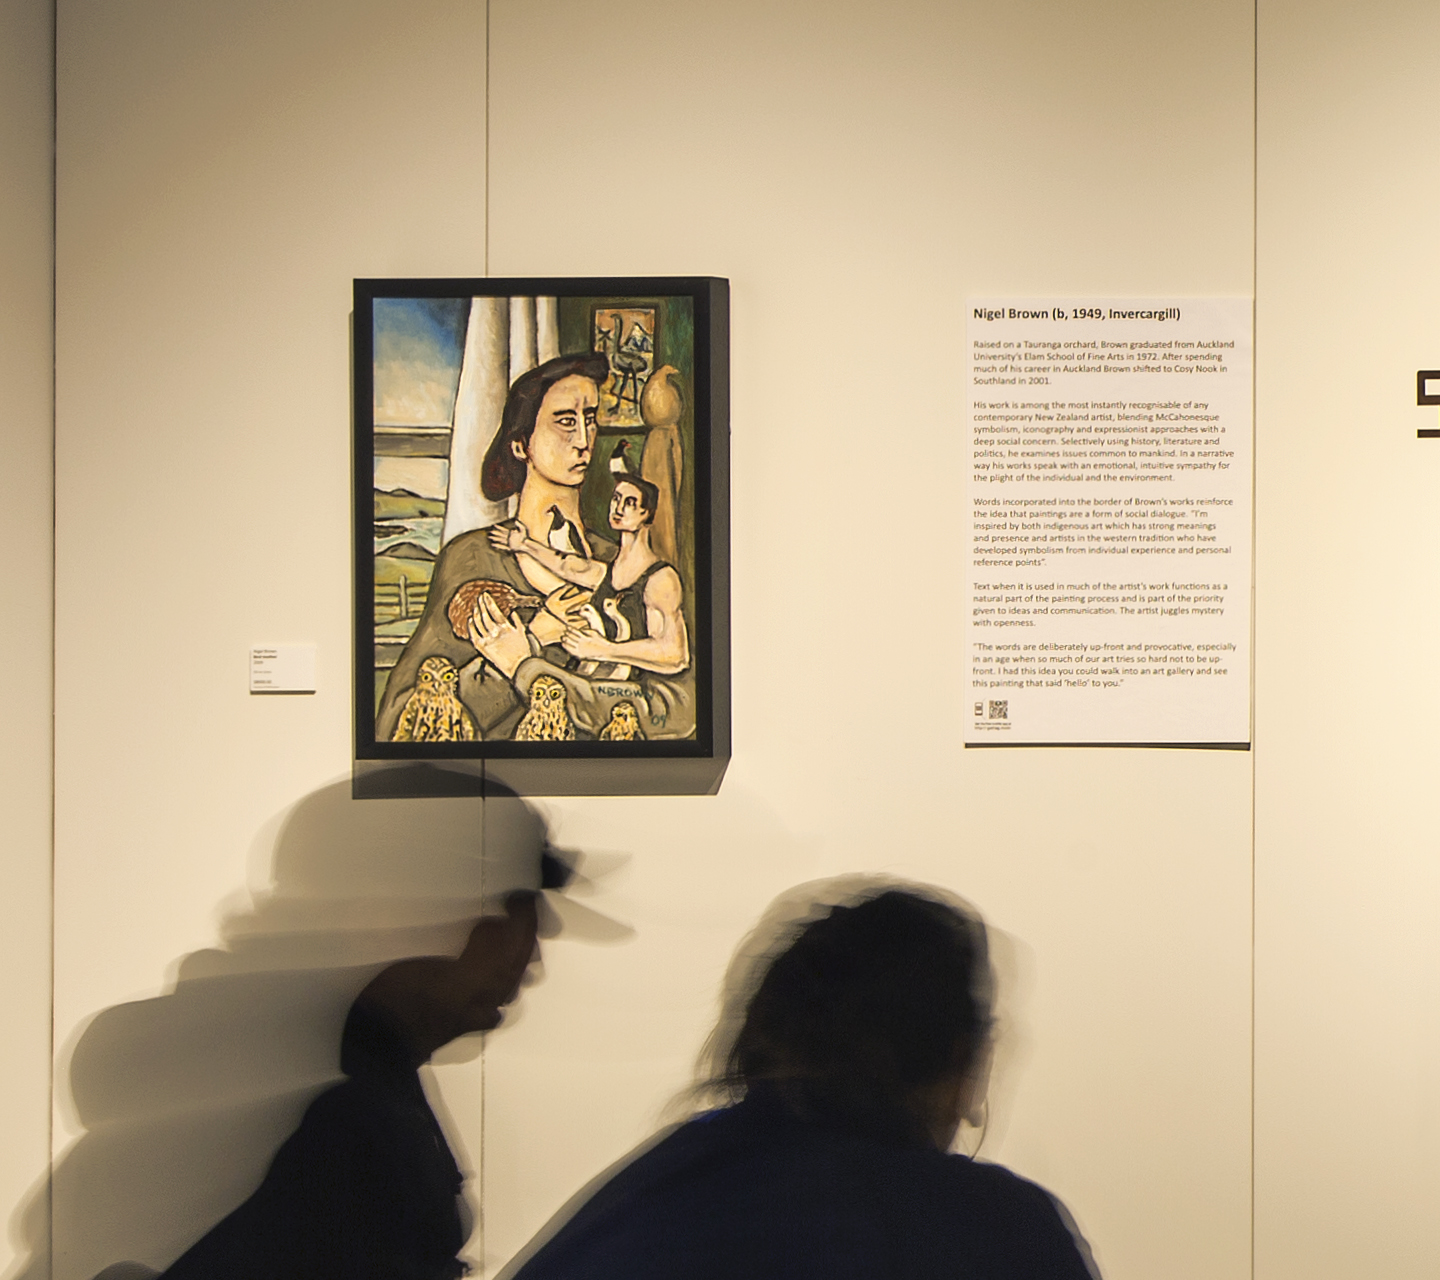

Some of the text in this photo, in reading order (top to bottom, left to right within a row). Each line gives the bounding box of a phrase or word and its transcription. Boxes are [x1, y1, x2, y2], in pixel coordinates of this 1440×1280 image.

[973, 308, 1005, 321] Nigel
[1008, 308, 1049, 319] Brown
[1109, 307, 1181, 321] Invercargill)
[1023, 340, 1062, 350] Tauranga
[1129, 340, 1173, 350] graduated
[1174, 340, 1195, 348] from
[1196, 340, 1235, 348] Auckland
[973, 365, 997, 373] much
[999, 364, 1008, 373] of
[1010, 364, 1022, 373] his
[1062, 365, 1102, 373] Auckland
[1103, 365, 1131, 373] Brown
[1132, 365, 1162, 373] shifted
[1174, 365, 1194, 374] Cosy
[1195, 365, 1218, 373] Nook
[973, 377, 1017, 385] Southland
[1018, 377, 1027, 385] in
